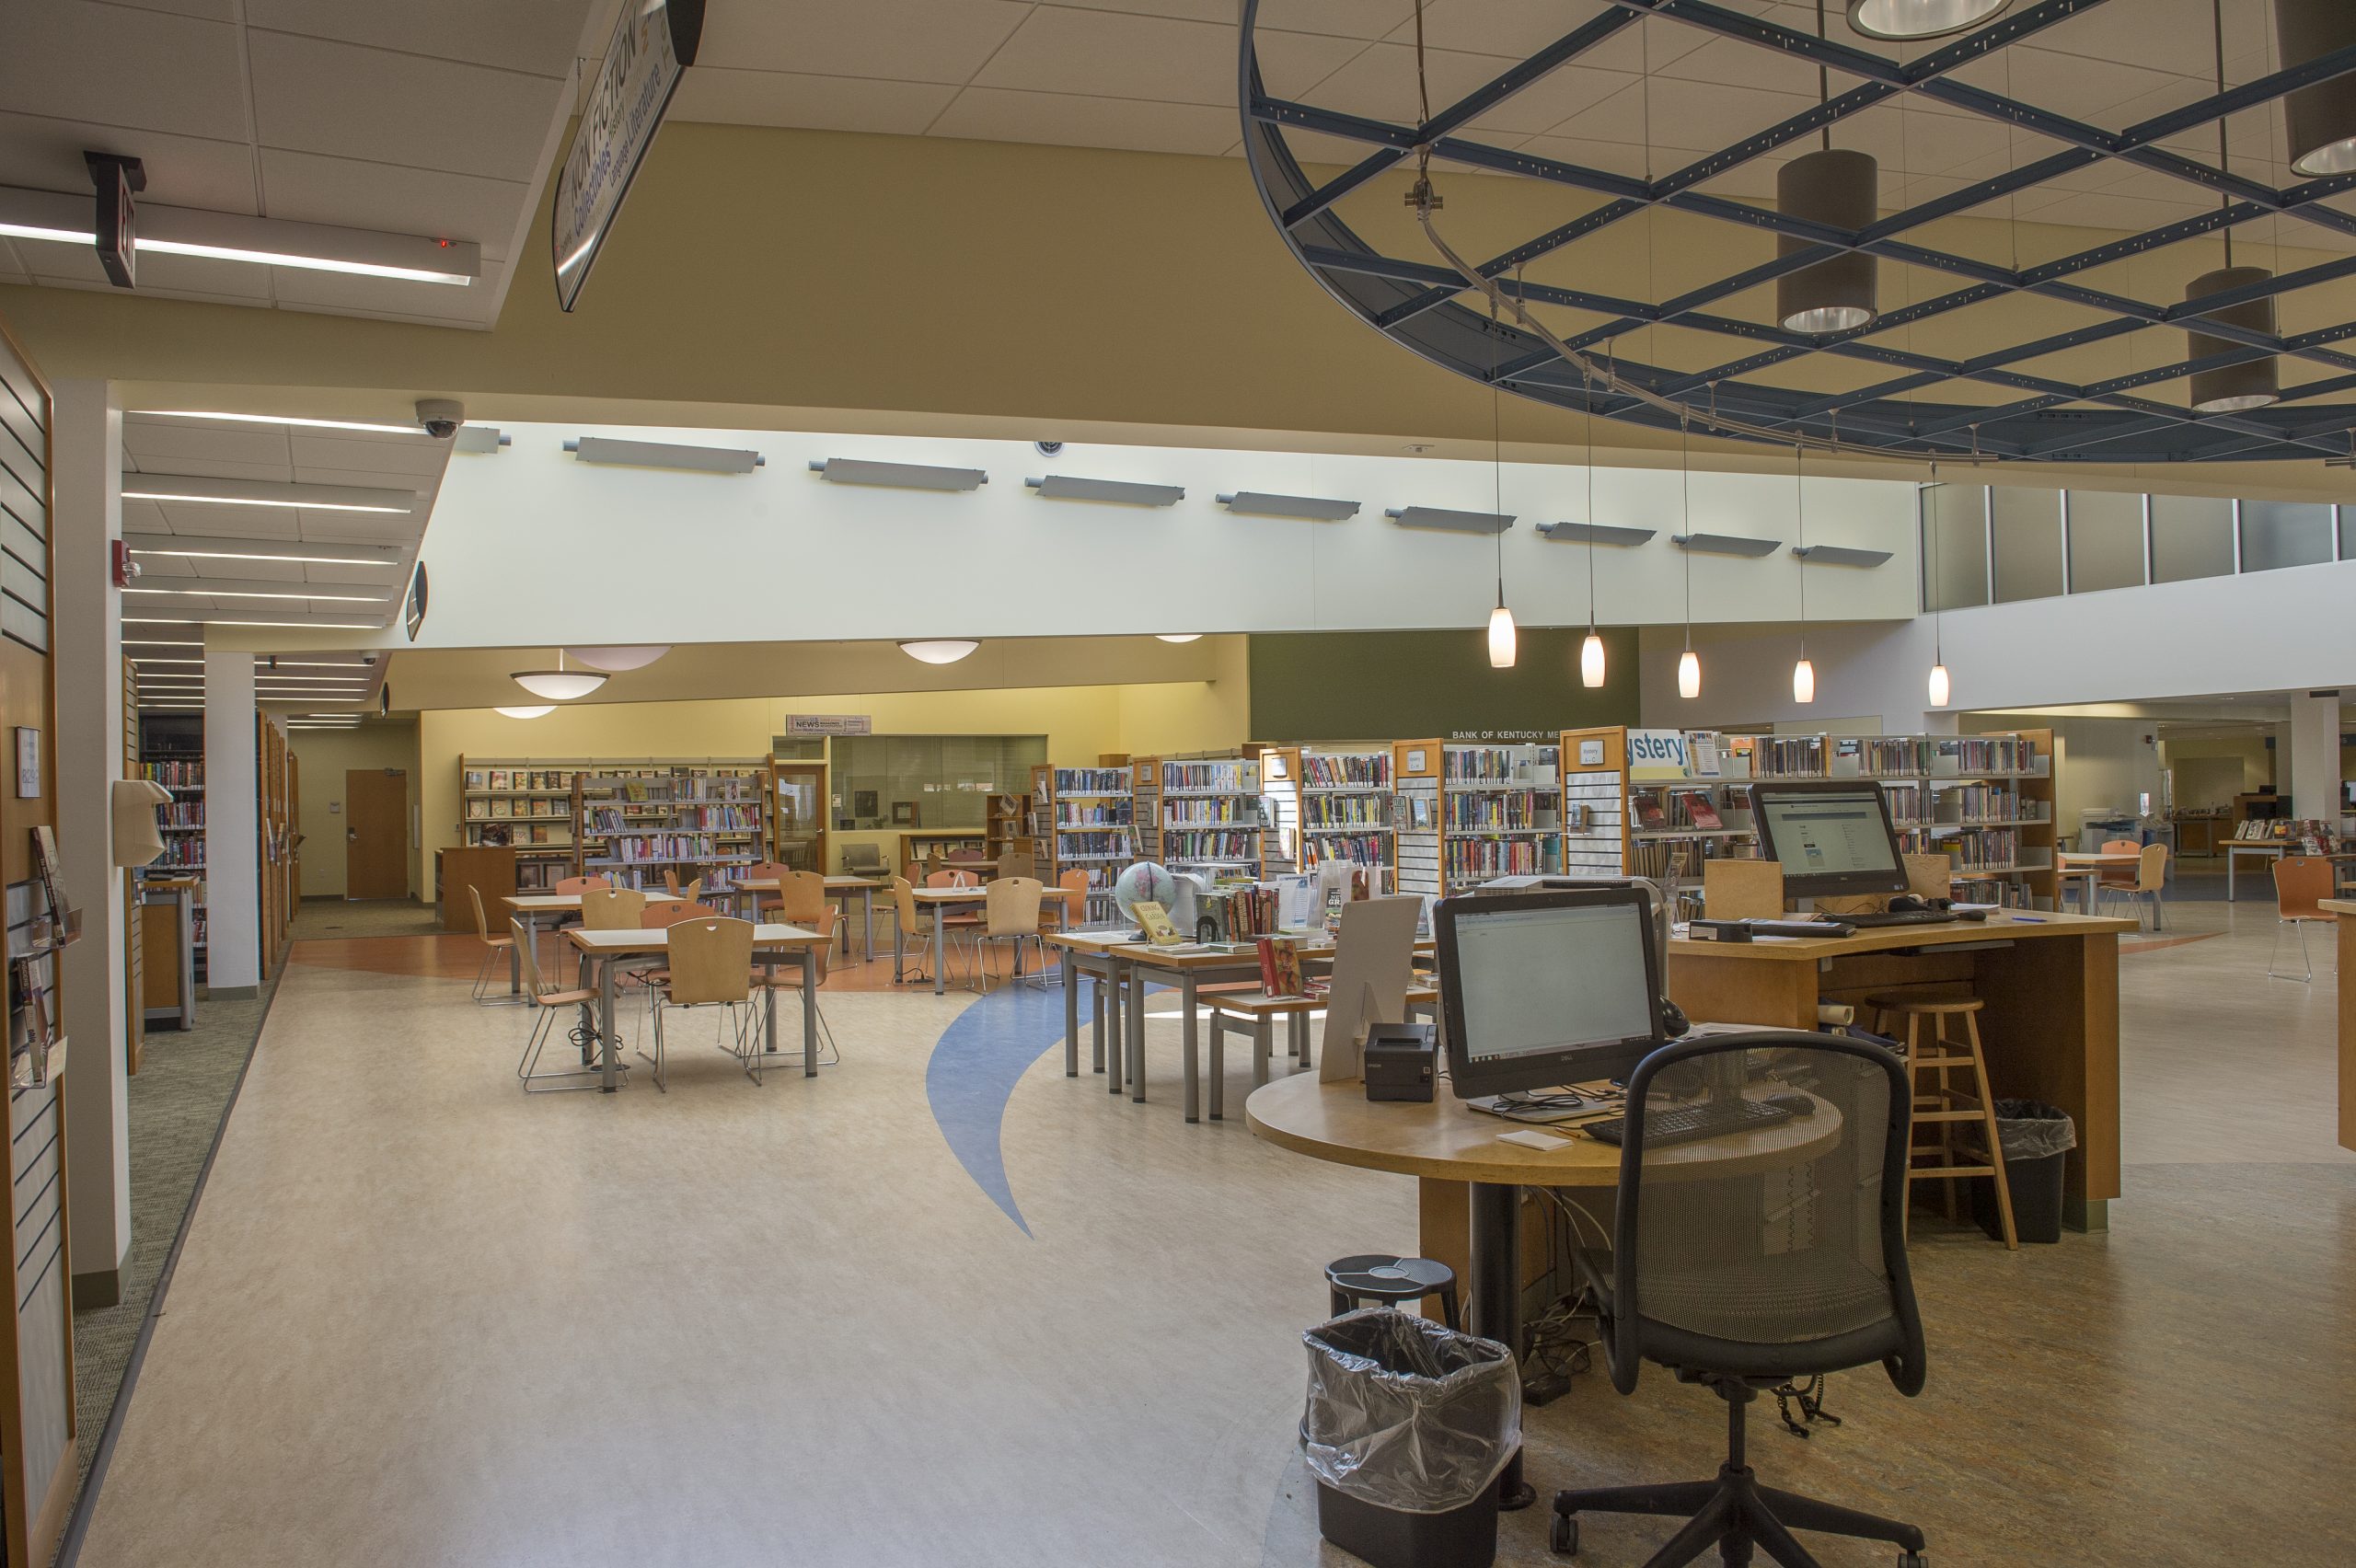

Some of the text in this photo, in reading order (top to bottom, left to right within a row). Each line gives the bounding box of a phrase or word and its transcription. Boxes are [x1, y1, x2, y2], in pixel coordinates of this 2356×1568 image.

[571, 126, 591, 207] NON
[593, 6, 637, 155] FICTION
[626, 63, 661, 147] Literature
[574, 142, 611, 237] Collectibles
[608, 98, 625, 146] History
[1452, 731, 1478, 739] BANK
[1481, 731, 1494, 739] OF
[1496, 731, 1544, 739] KENTUCKY
